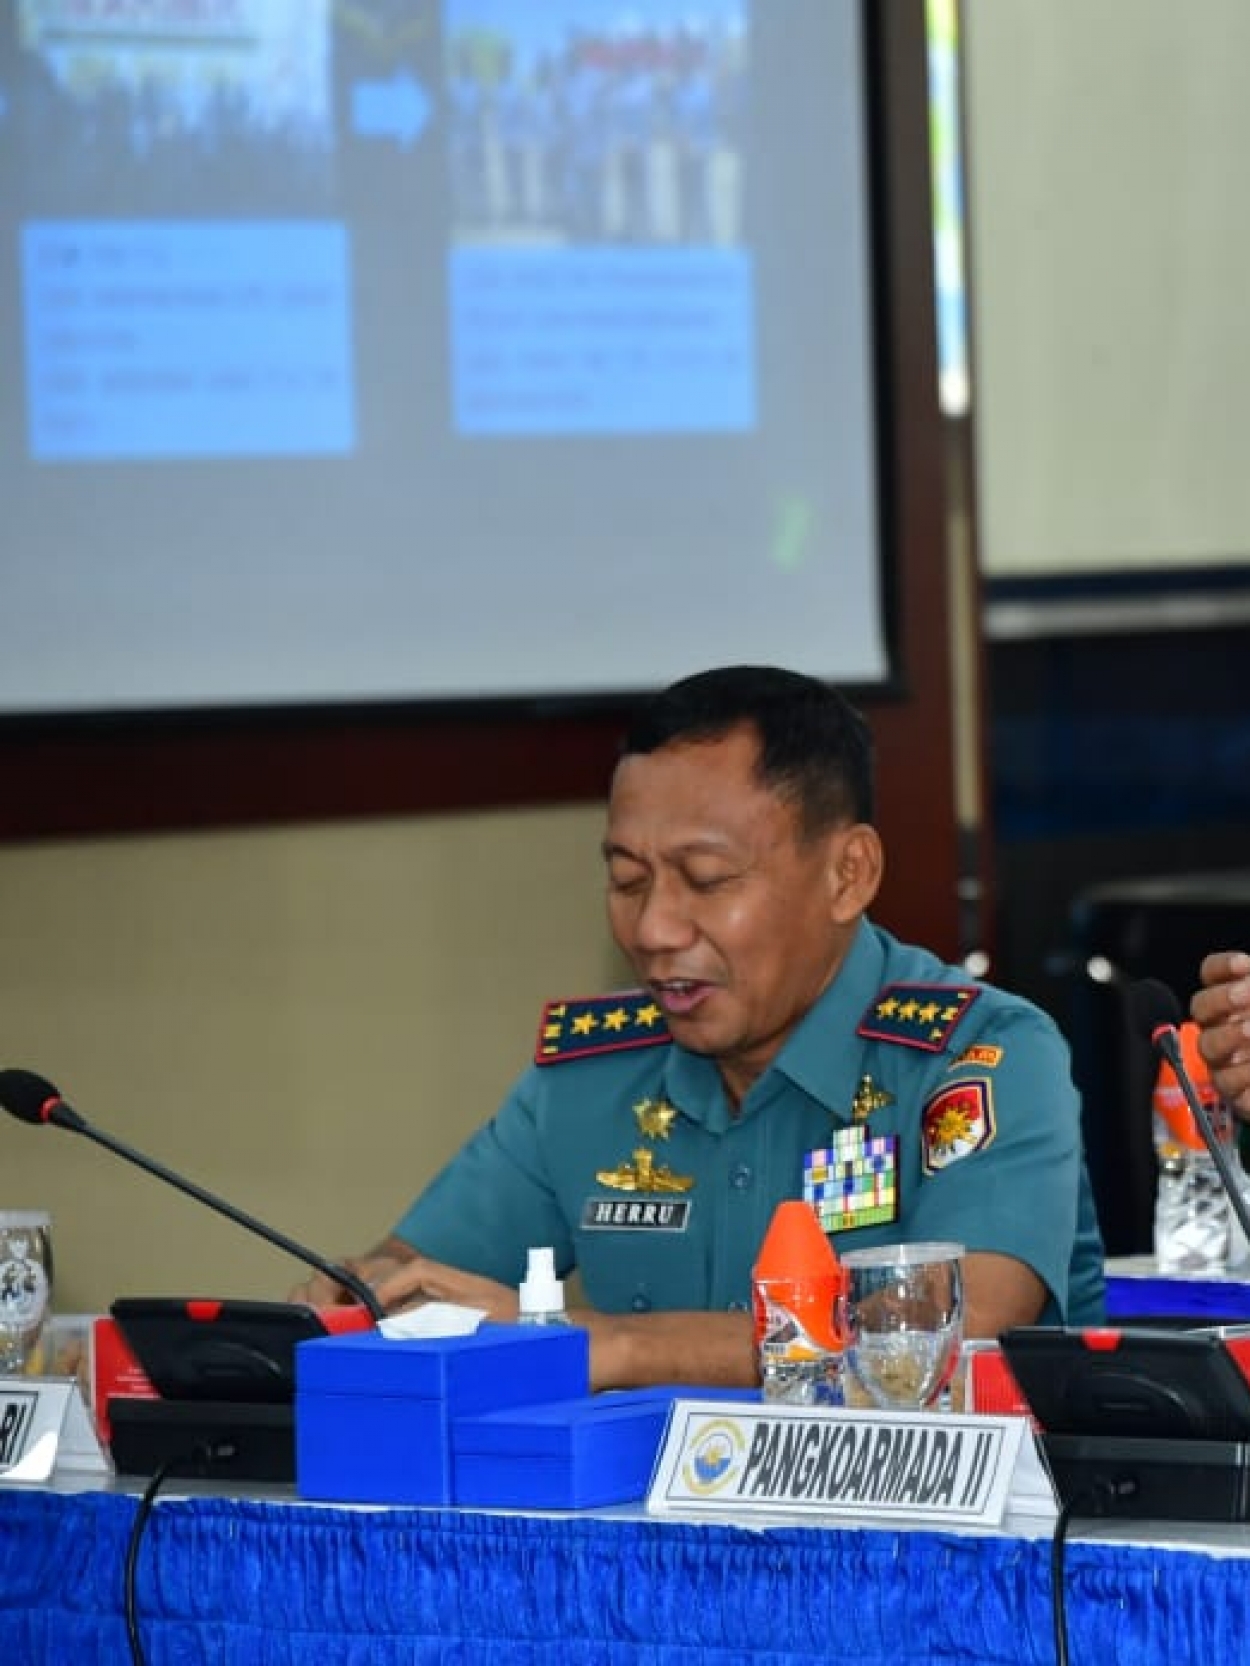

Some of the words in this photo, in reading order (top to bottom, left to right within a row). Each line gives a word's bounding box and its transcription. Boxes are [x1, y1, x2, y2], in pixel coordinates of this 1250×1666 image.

[595, 1203, 674, 1224] HERRU
[737, 1421, 963, 1505] PANGKOARMADA
[960, 1433, 994, 1506] II
